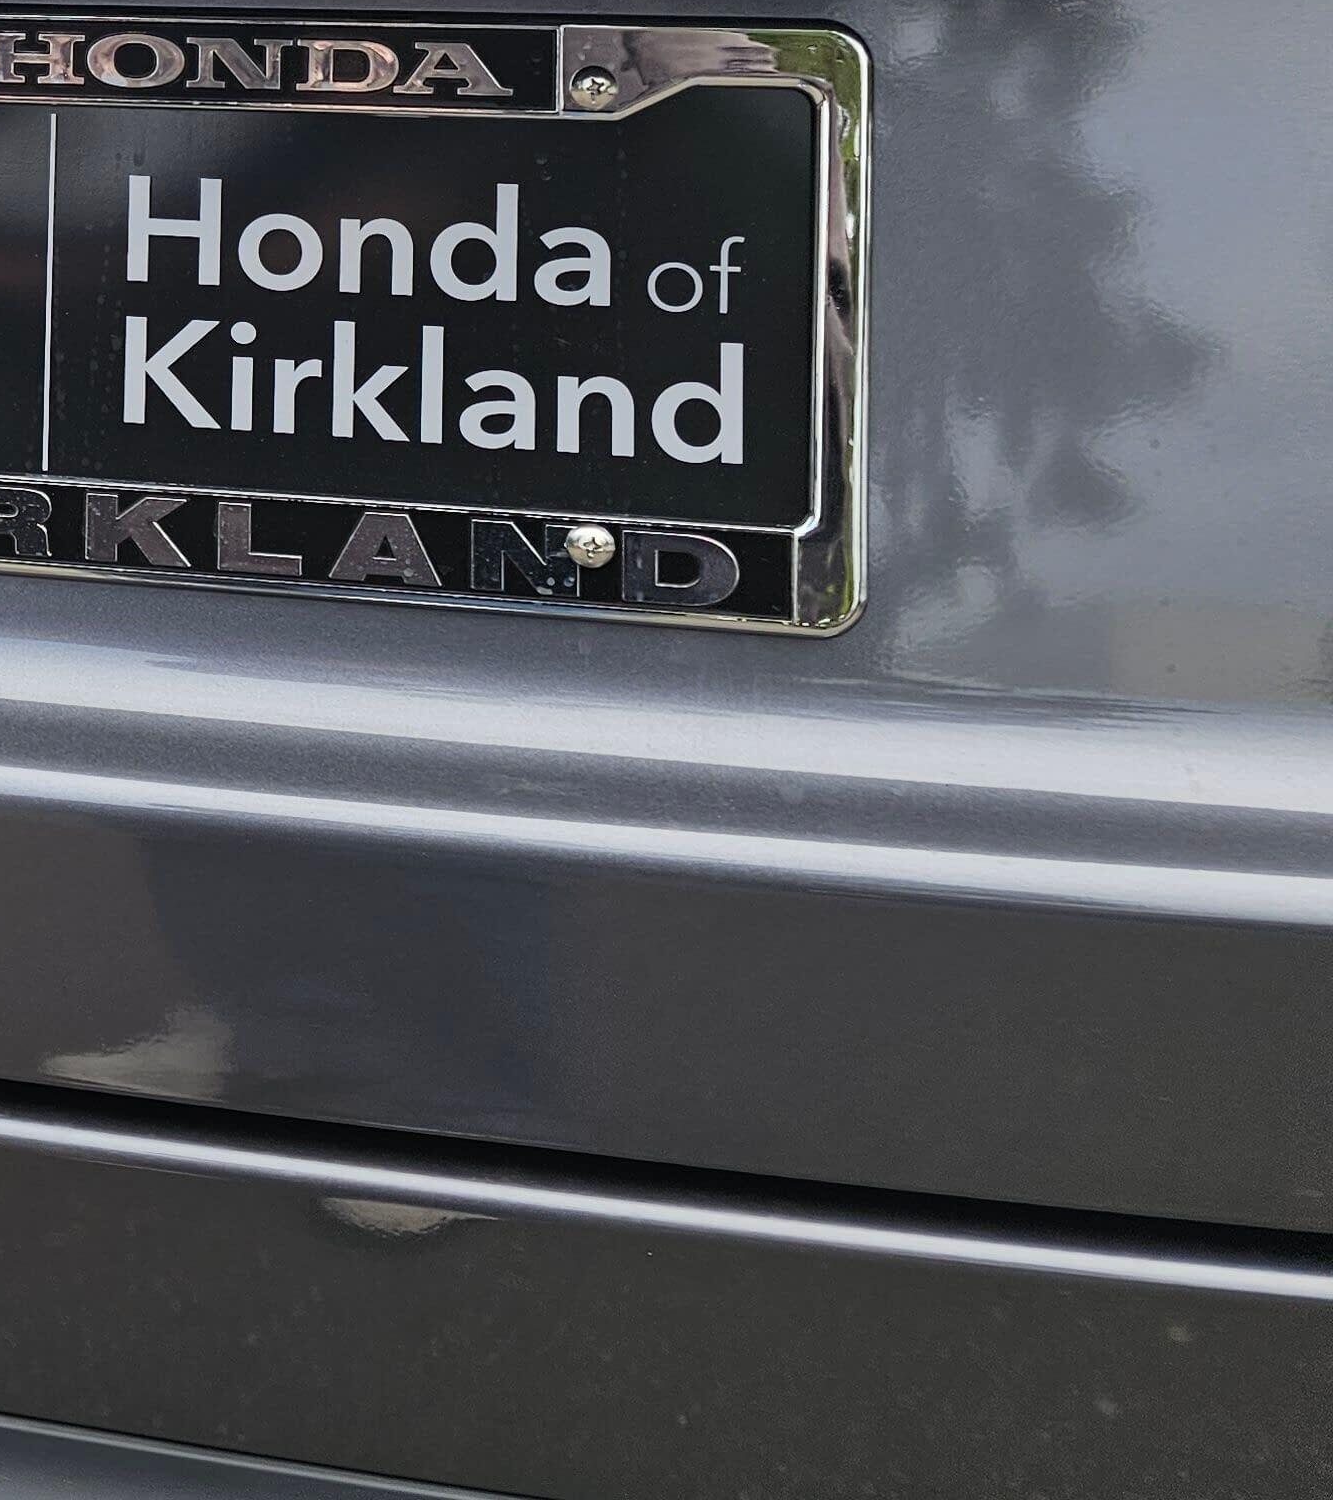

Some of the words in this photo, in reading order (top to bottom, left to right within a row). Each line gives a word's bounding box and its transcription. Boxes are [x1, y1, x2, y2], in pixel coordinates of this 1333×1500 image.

[126, 175, 613, 307] Honda
[647, 237, 743, 314] of
[123, 316, 743, 465] Kirkland
